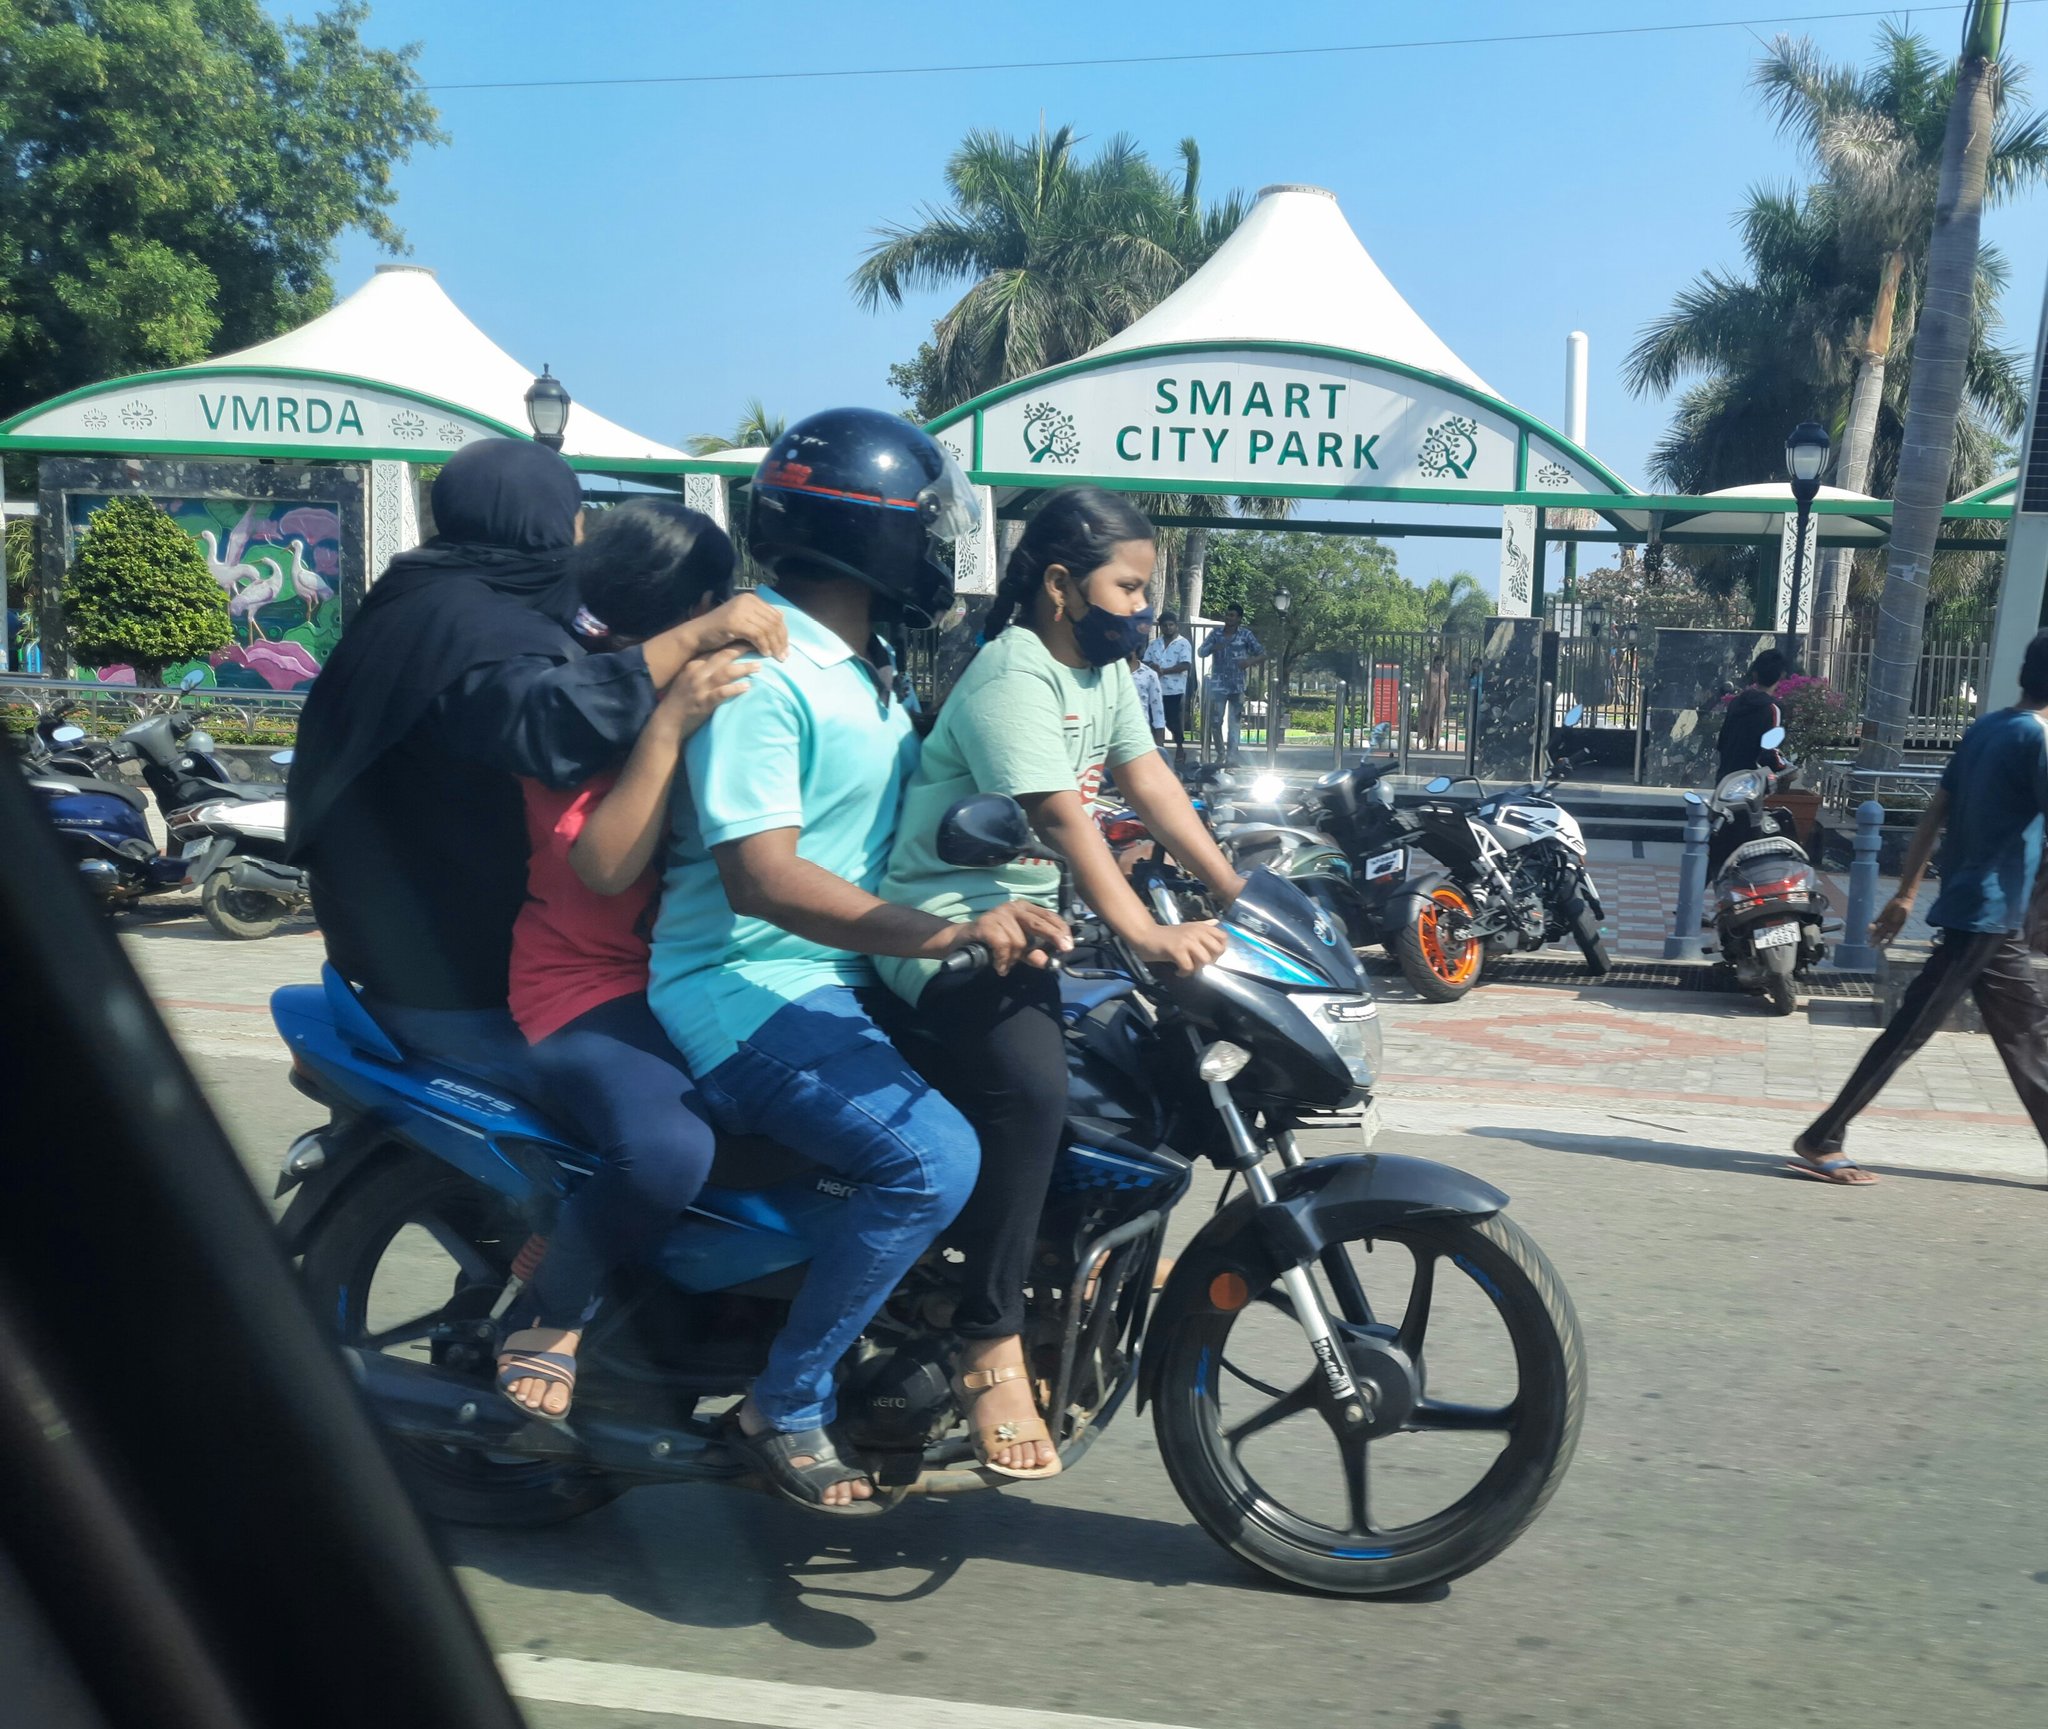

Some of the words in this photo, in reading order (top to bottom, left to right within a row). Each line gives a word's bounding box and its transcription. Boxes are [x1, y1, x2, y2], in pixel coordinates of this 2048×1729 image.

[198, 394, 364, 436] VMRDA
[1155, 377, 1347, 420] SMART
[1115, 424, 1230, 464] CITY
[1249, 429, 1380, 471] PARK
